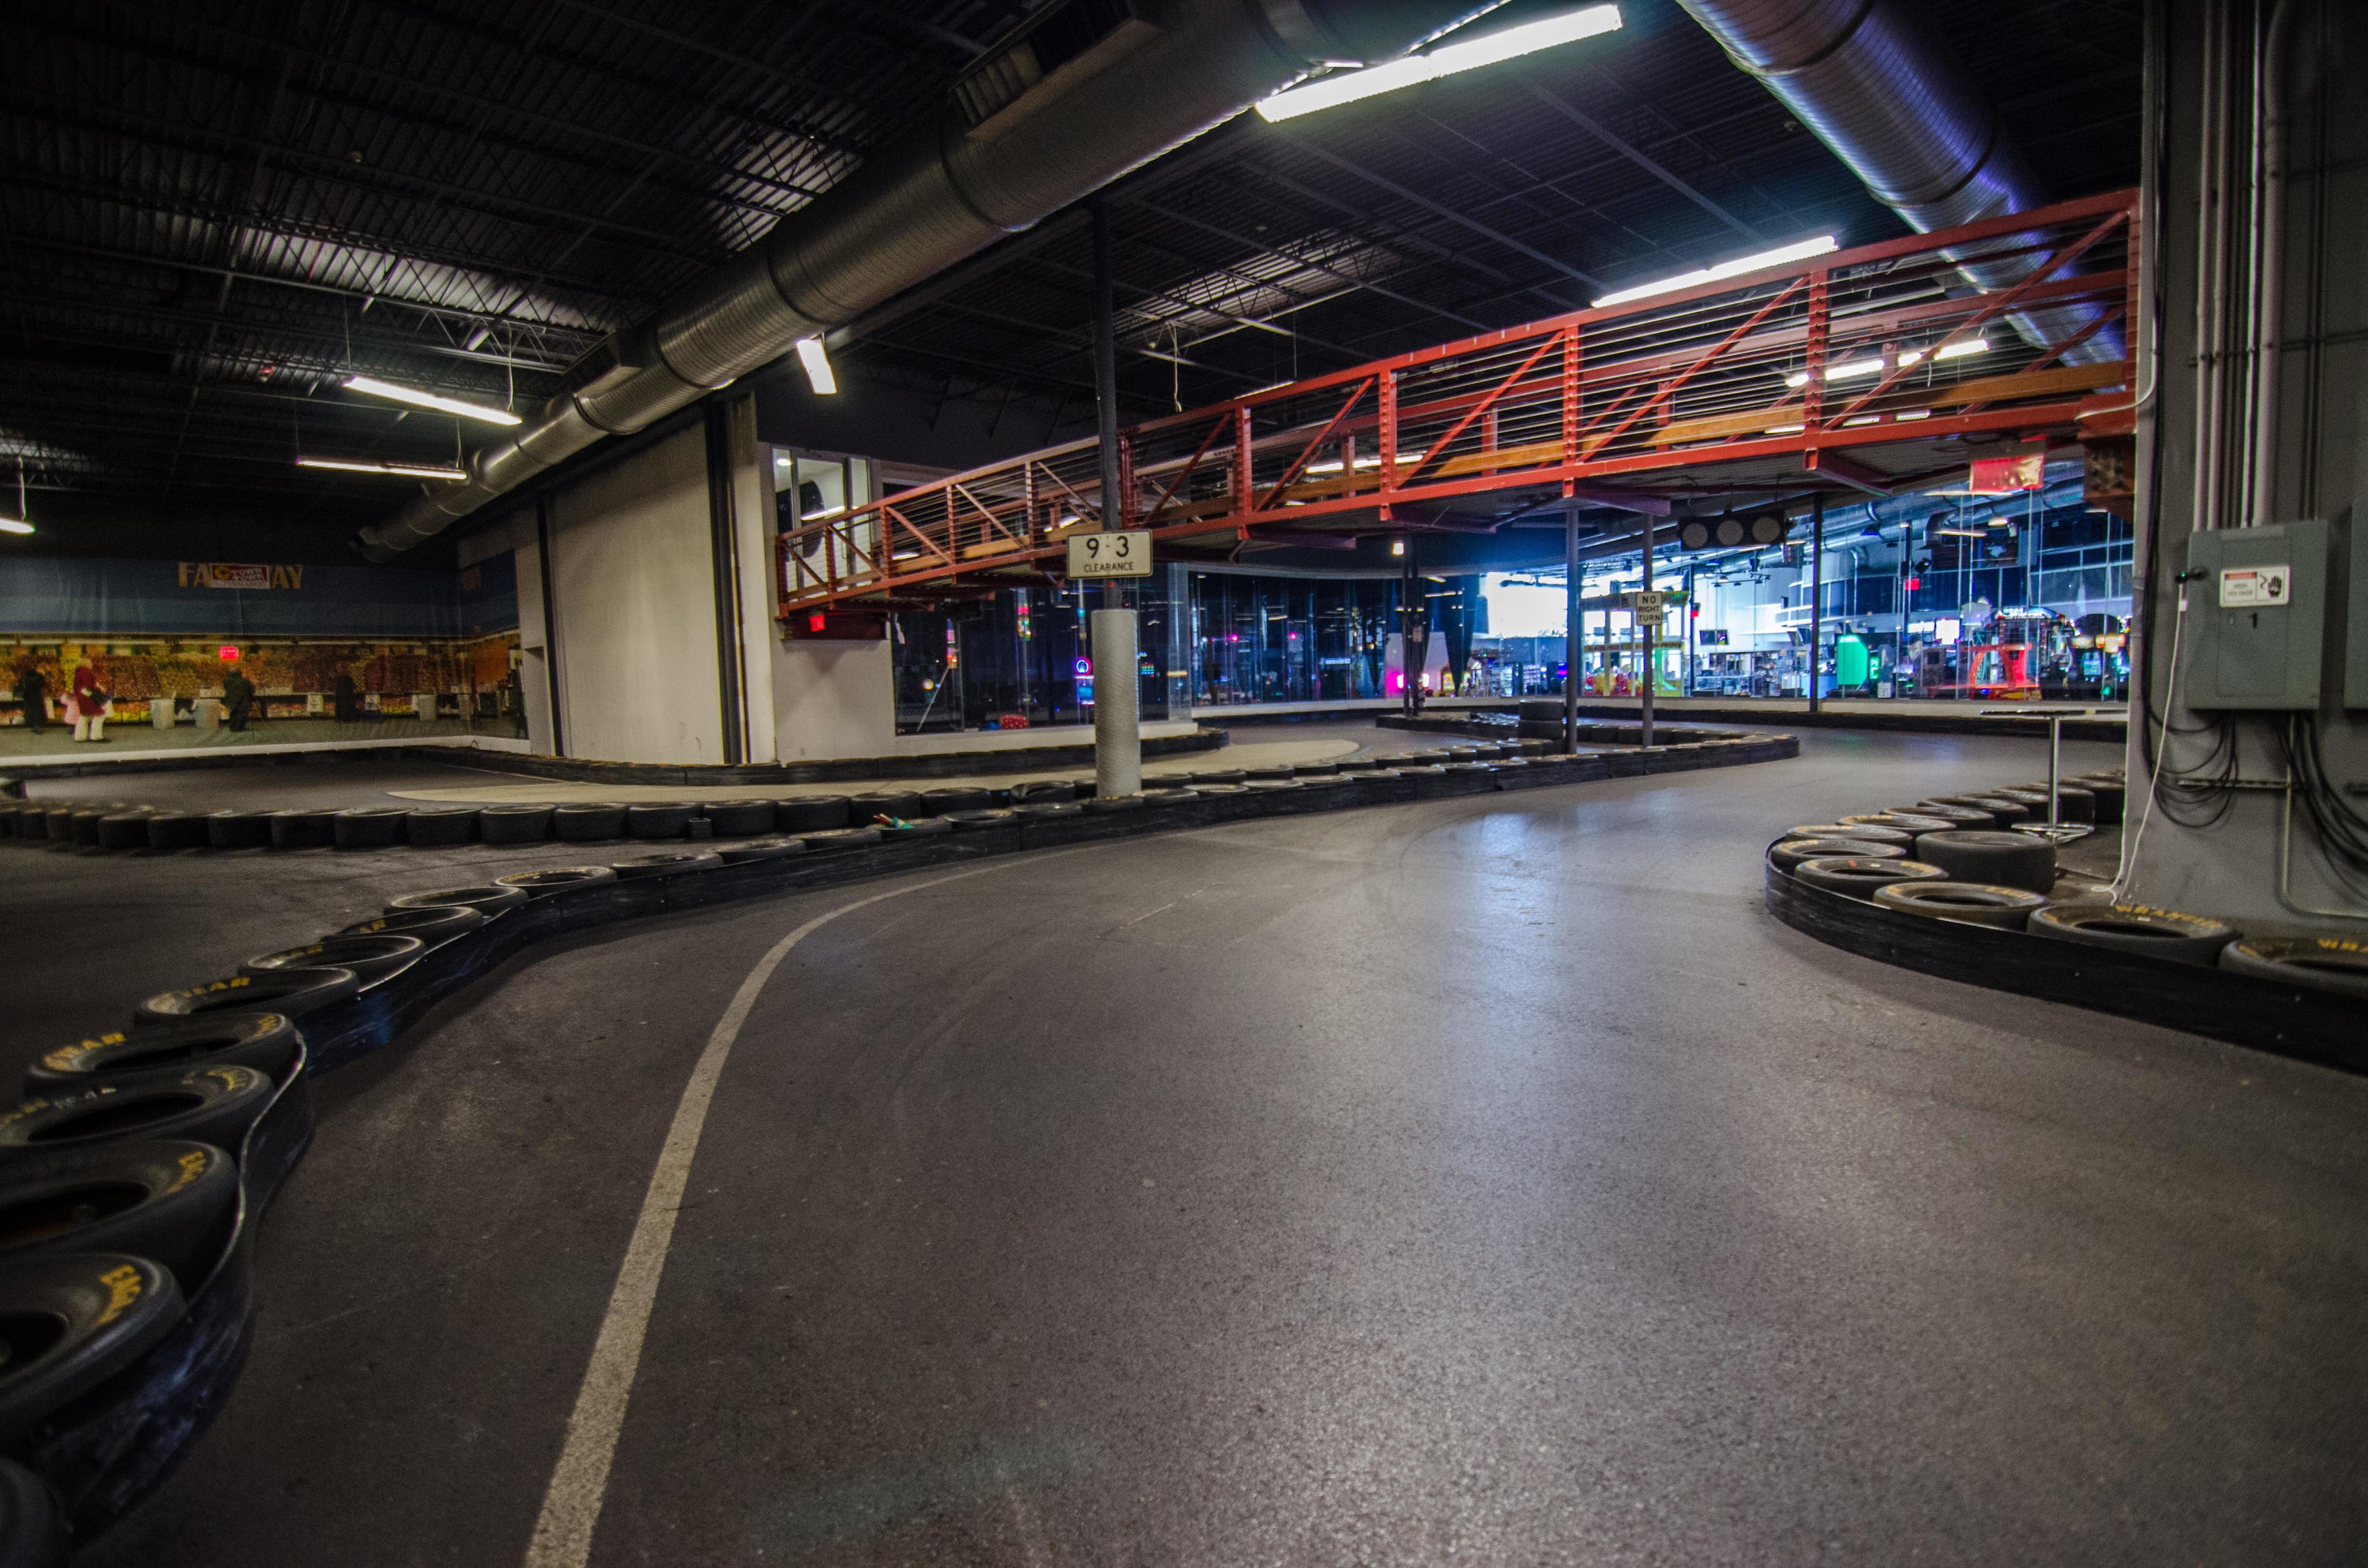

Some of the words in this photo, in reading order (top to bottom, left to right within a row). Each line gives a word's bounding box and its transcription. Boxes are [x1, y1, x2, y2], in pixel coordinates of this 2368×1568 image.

[1084, 562, 1134, 573] CLEARANCE
[178, 562, 303, 589] FAAY
[1642, 595, 1656, 604] NO
